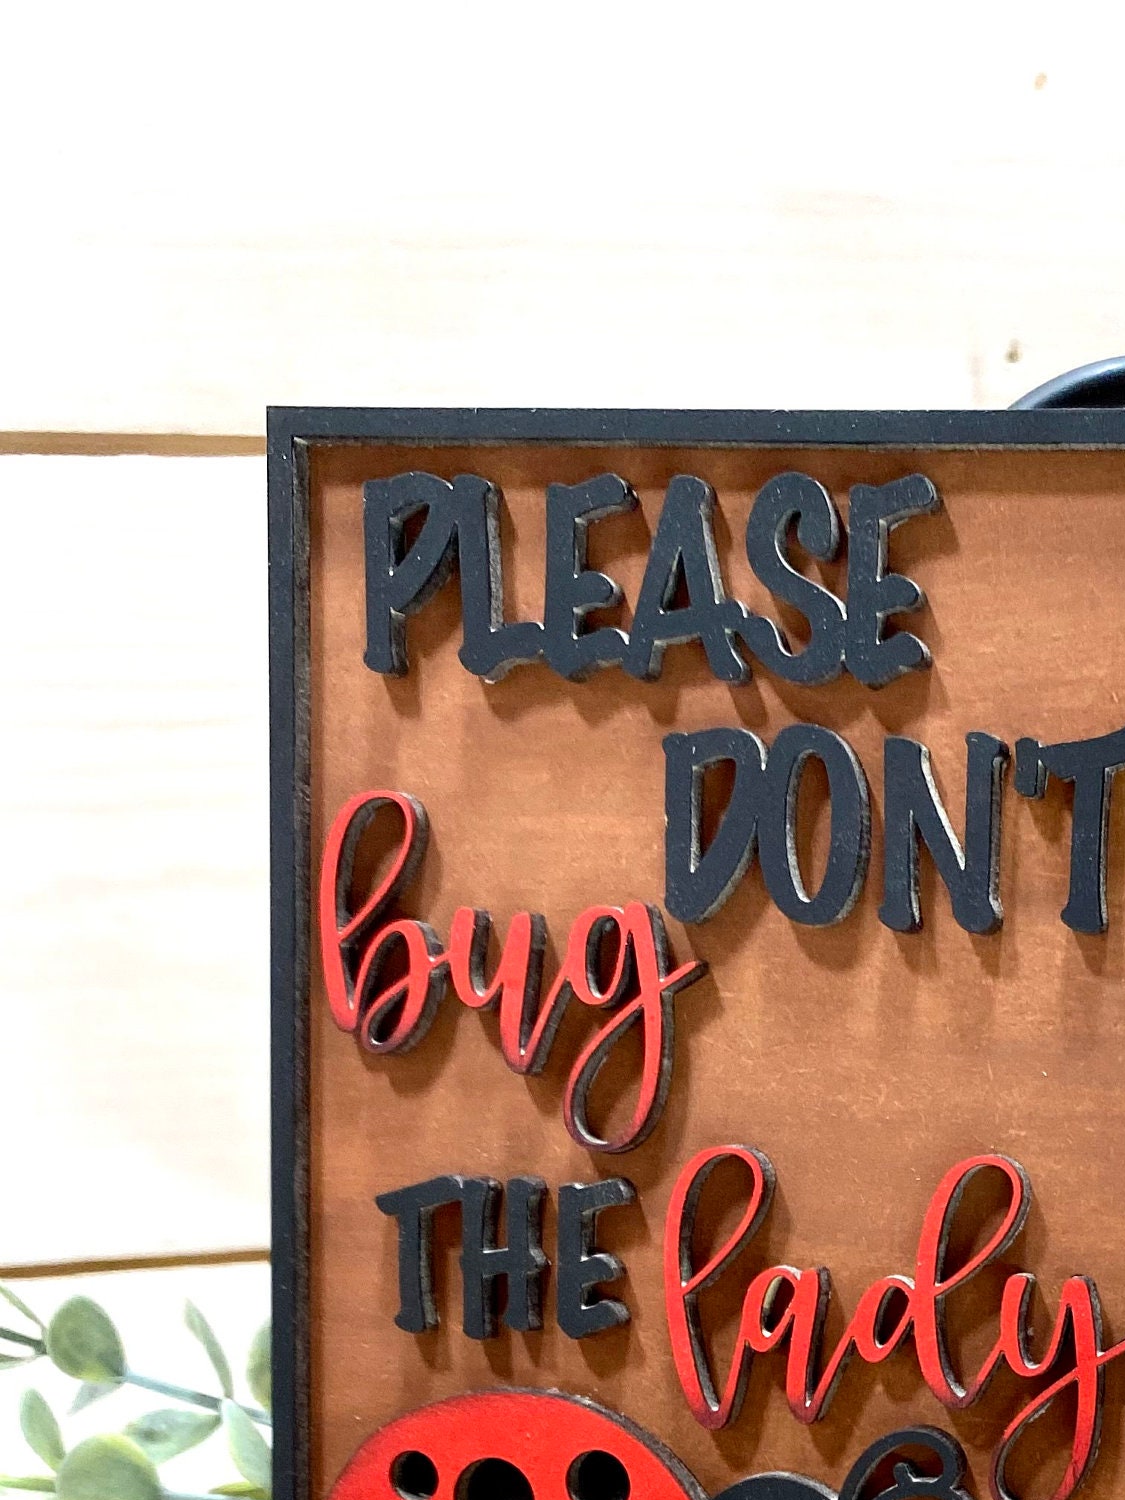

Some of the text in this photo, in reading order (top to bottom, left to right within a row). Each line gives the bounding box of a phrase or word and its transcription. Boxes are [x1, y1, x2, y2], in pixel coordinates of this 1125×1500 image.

[362, 471, 944, 688] PLEASE
[319, 790, 708, 1155] bug
[375, 1173, 635, 1341] THE
